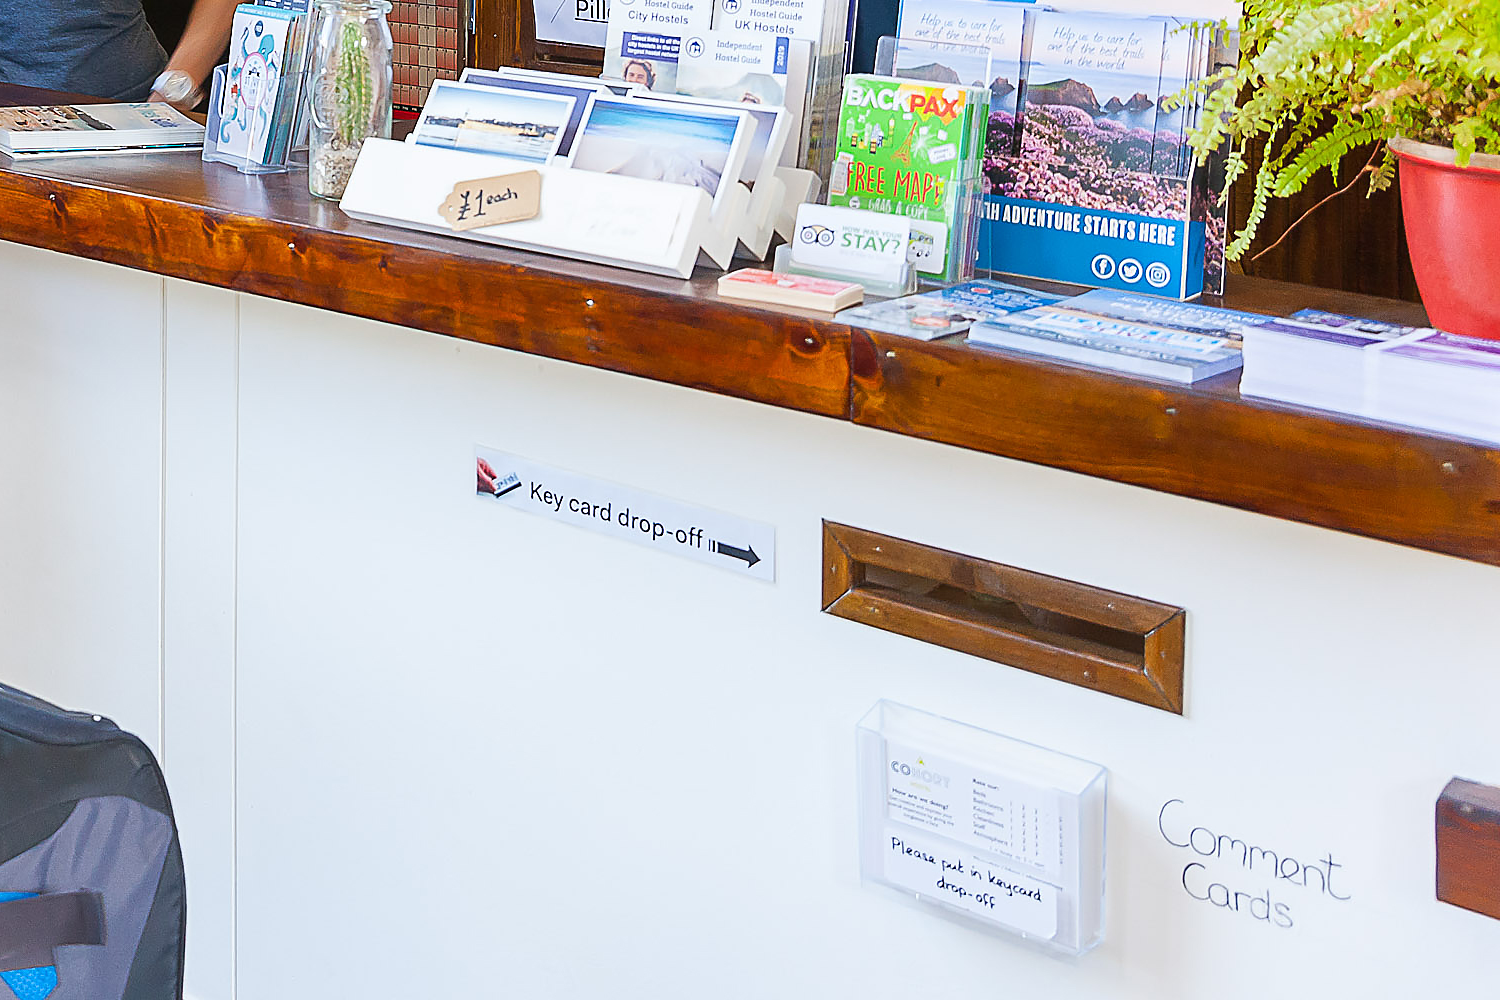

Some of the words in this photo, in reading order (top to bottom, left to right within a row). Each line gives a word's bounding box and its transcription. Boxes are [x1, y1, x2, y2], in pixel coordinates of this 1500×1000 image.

[644, 0, 669, 10] Hostel
[671, 1, 694, 12] Guide
[749, 9, 776, 20] Hostel
[777, 11, 803, 21] Guide
[628, 10, 648, 23] City
[650, 12, 689, 25] Hostels
[734, 20, 750, 31] UK
[753, 21, 795, 35] Hostels
[716, 40, 763, 53] Independent
[1053, 26, 1076, 44] Help
[1078, 33, 1088, 41] us
[1094, 31, 1103, 43] to
[1107, 35, 1124, 44] care
[1126, 31, 1142, 47] for
[715, 52, 740, 63] Hostel
[741, 55, 762, 65] Guide
[776, 46, 785, 68] 2019
[1047, 43, 1063, 51] one
[1066, 40, 1078, 54] of
[1081, 43, 1095, 54] the
[1100, 45, 1117, 57] best
[1122, 46, 1145, 59] trails
[1063, 56, 1073, 65] in
[1078, 56, 1092, 67] the
[1096, 57, 1126, 70] world
[846, 85, 959, 119] BACKPAX
[847, 161, 886, 194] FREE
[893, 169, 940, 206] MAP!
[457, 189, 486, 222] £1
[486, 187, 519, 207] each
[905, 203, 929, 220] COPY
[1002, 204, 1081, 233] ADVENTURE
[1083, 214, 1136, 242] STARTS
[1139, 221, 1177, 247] HERE
[841, 232, 901, 255] STAY?
[530, 480, 564, 513] Key
[569, 497, 612, 522] card
[618, 507, 704, 549] drop-off
[890, 760, 950, 789] COHORT
[1158, 798, 1351, 901] Comment
[891, 836, 936, 865] Please
[941, 859, 964, 873] put
[970, 866, 982, 880] in
[988, 870, 1042, 903] keycard
[936, 876, 997, 909] drop-off
[1182, 862, 1294, 930] Cards
